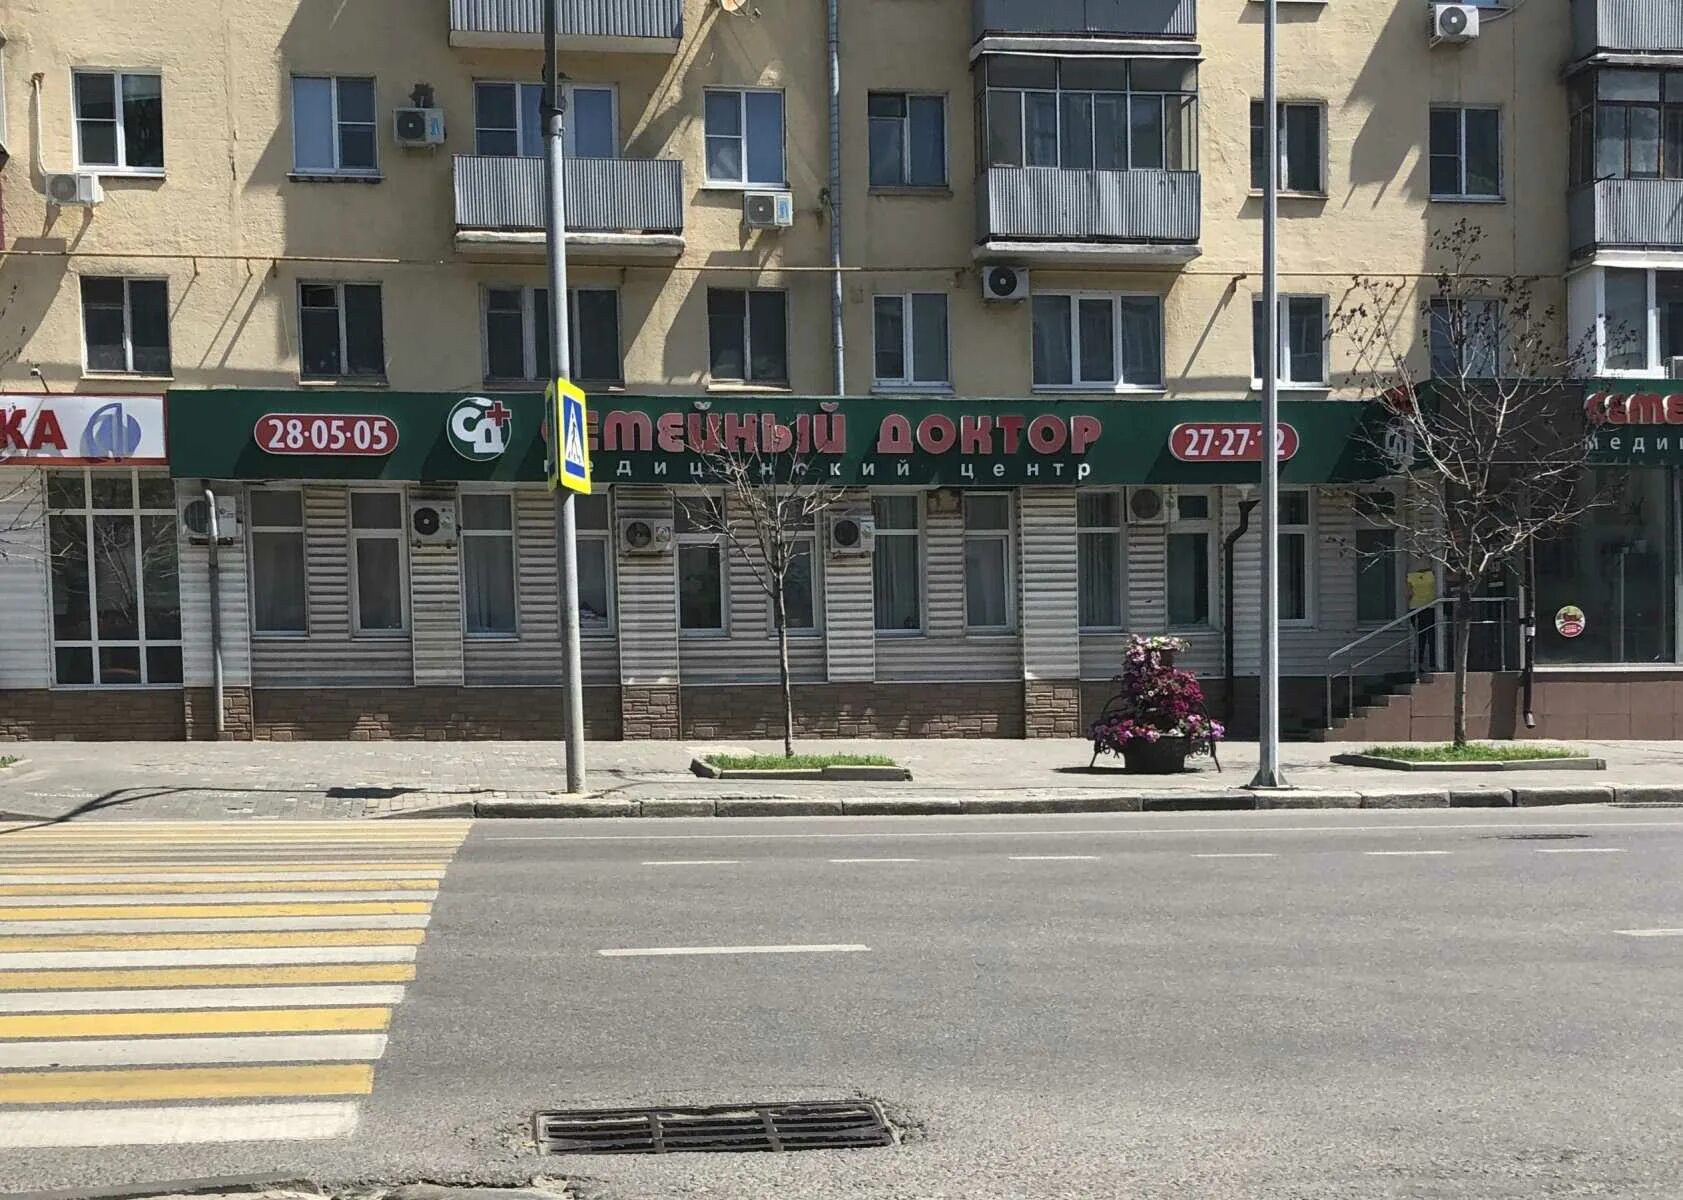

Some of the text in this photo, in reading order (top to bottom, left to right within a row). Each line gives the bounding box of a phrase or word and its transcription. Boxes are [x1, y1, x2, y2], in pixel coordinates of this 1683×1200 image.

[541, 401, 1102, 454] МЕЙНЫЙ ДОКТОР
[1184, 428, 1285, 455] 27·27·2
[1585, 436, 1683, 453] меди
[961, 462, 1091, 480] центр
